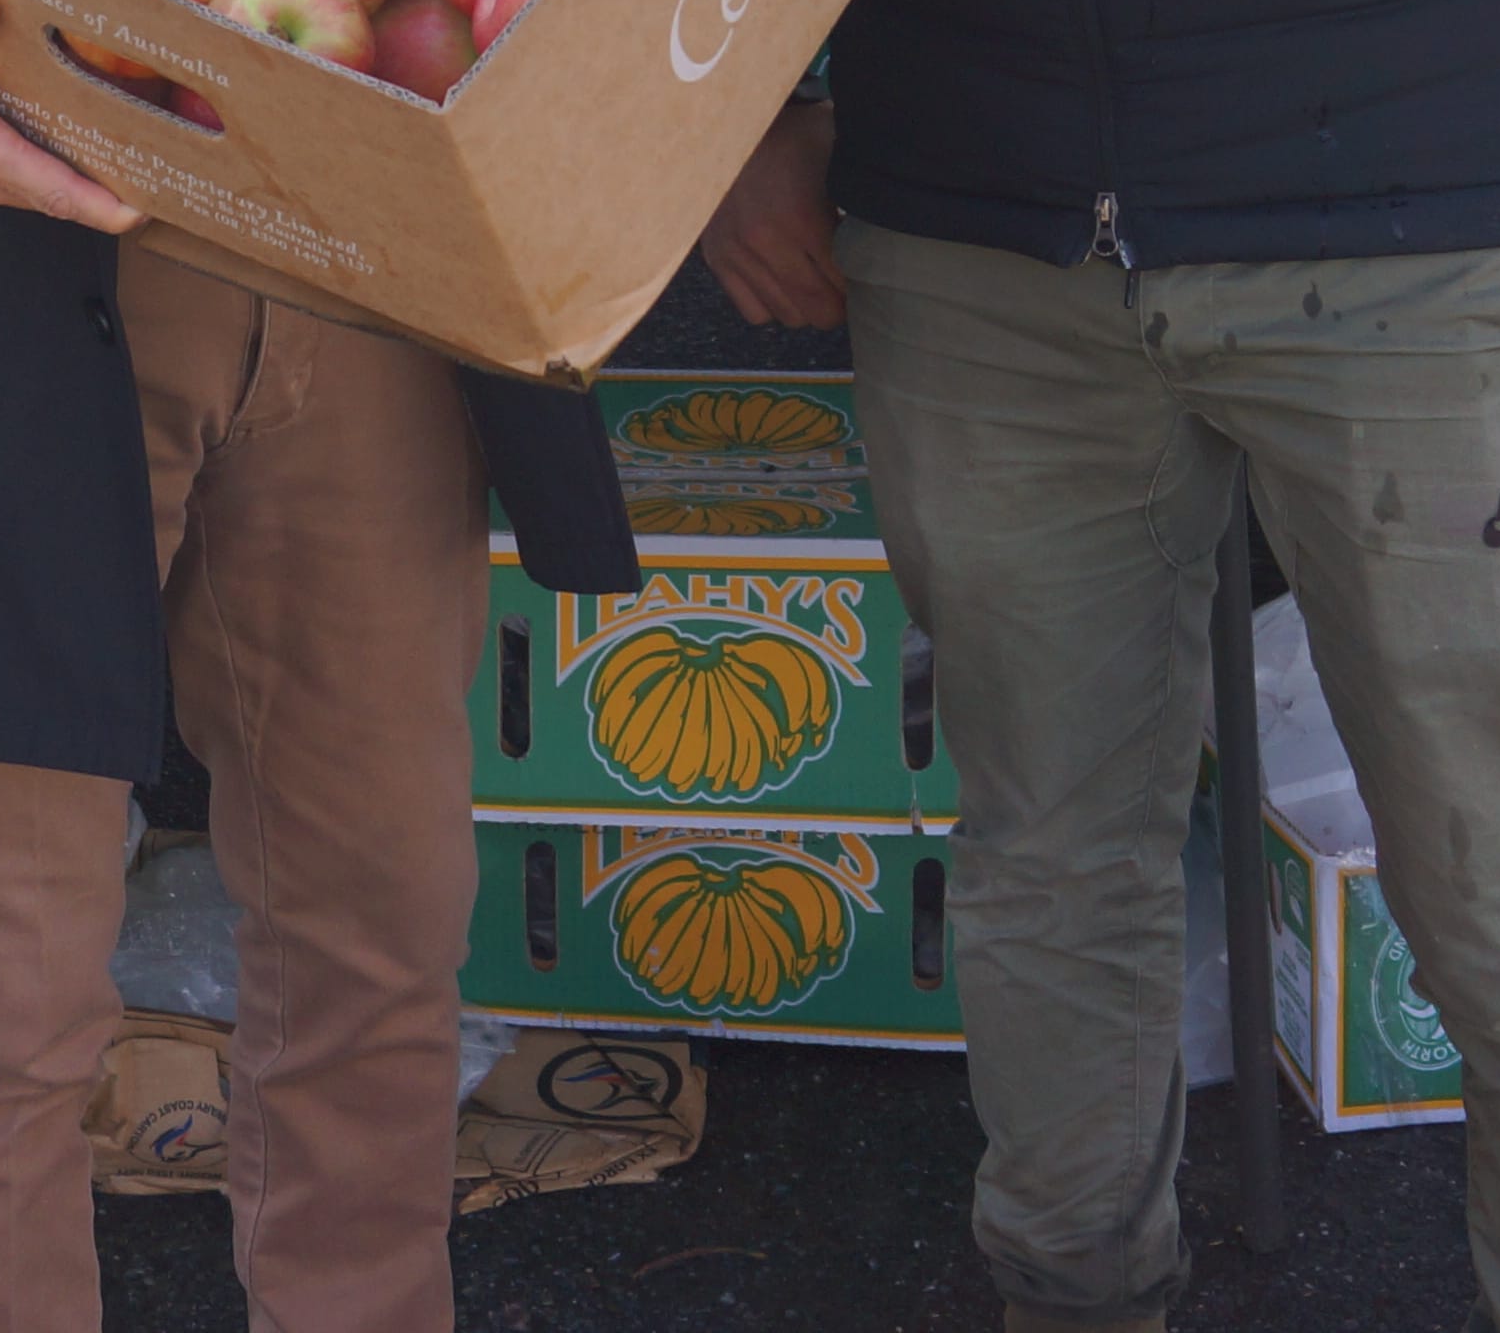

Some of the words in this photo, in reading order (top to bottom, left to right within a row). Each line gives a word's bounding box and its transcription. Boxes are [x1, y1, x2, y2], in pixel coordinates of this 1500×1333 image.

[83, 12, 108, 35] of
[114, 24, 231, 87] Australia
[57, 112, 145, 163] Orchards
[151, 154, 268, 220] Proprietary
[556, 572, 872, 687] LEAHY'S
